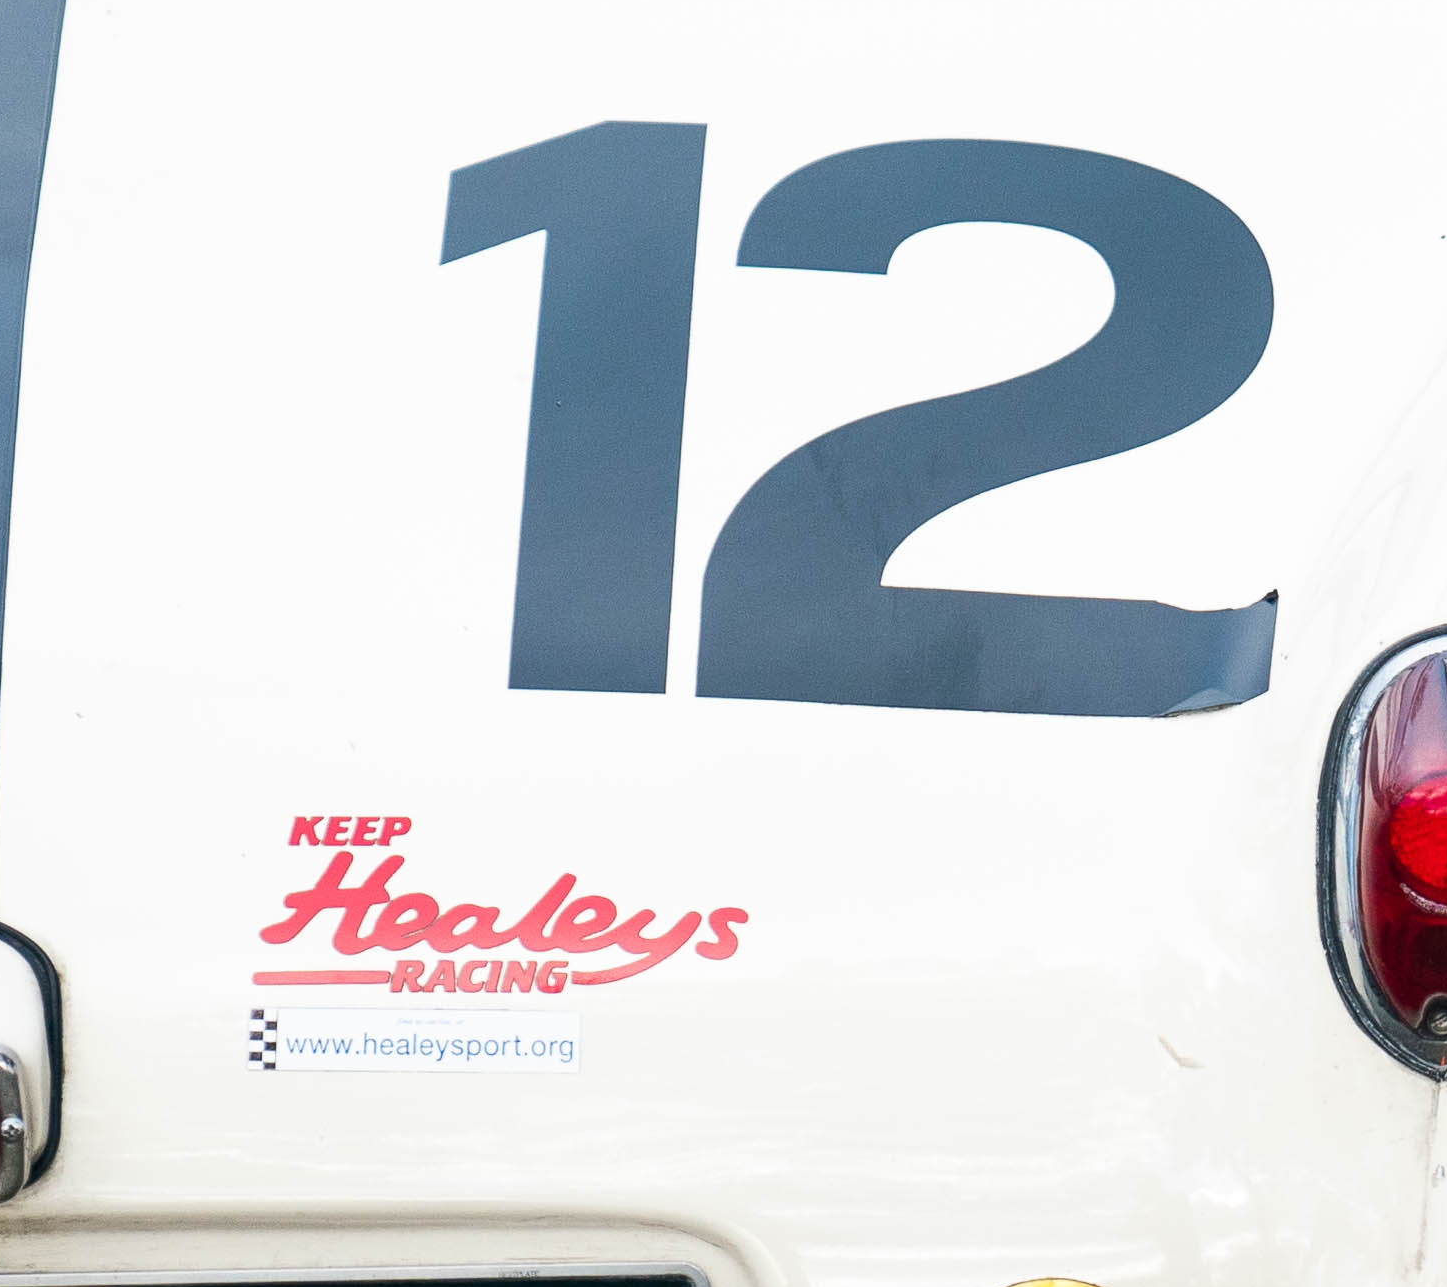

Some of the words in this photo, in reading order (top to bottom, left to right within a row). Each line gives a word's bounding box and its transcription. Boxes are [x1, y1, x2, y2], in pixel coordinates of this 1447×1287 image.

[439, 119, 1277, 719] 12
[287, 815, 412, 847] KEEP
[259, 850, 750, 987] Healeys
[389, 959, 570, 994] RACING
[285, 1030, 575, 1064] www.healeysport.org
